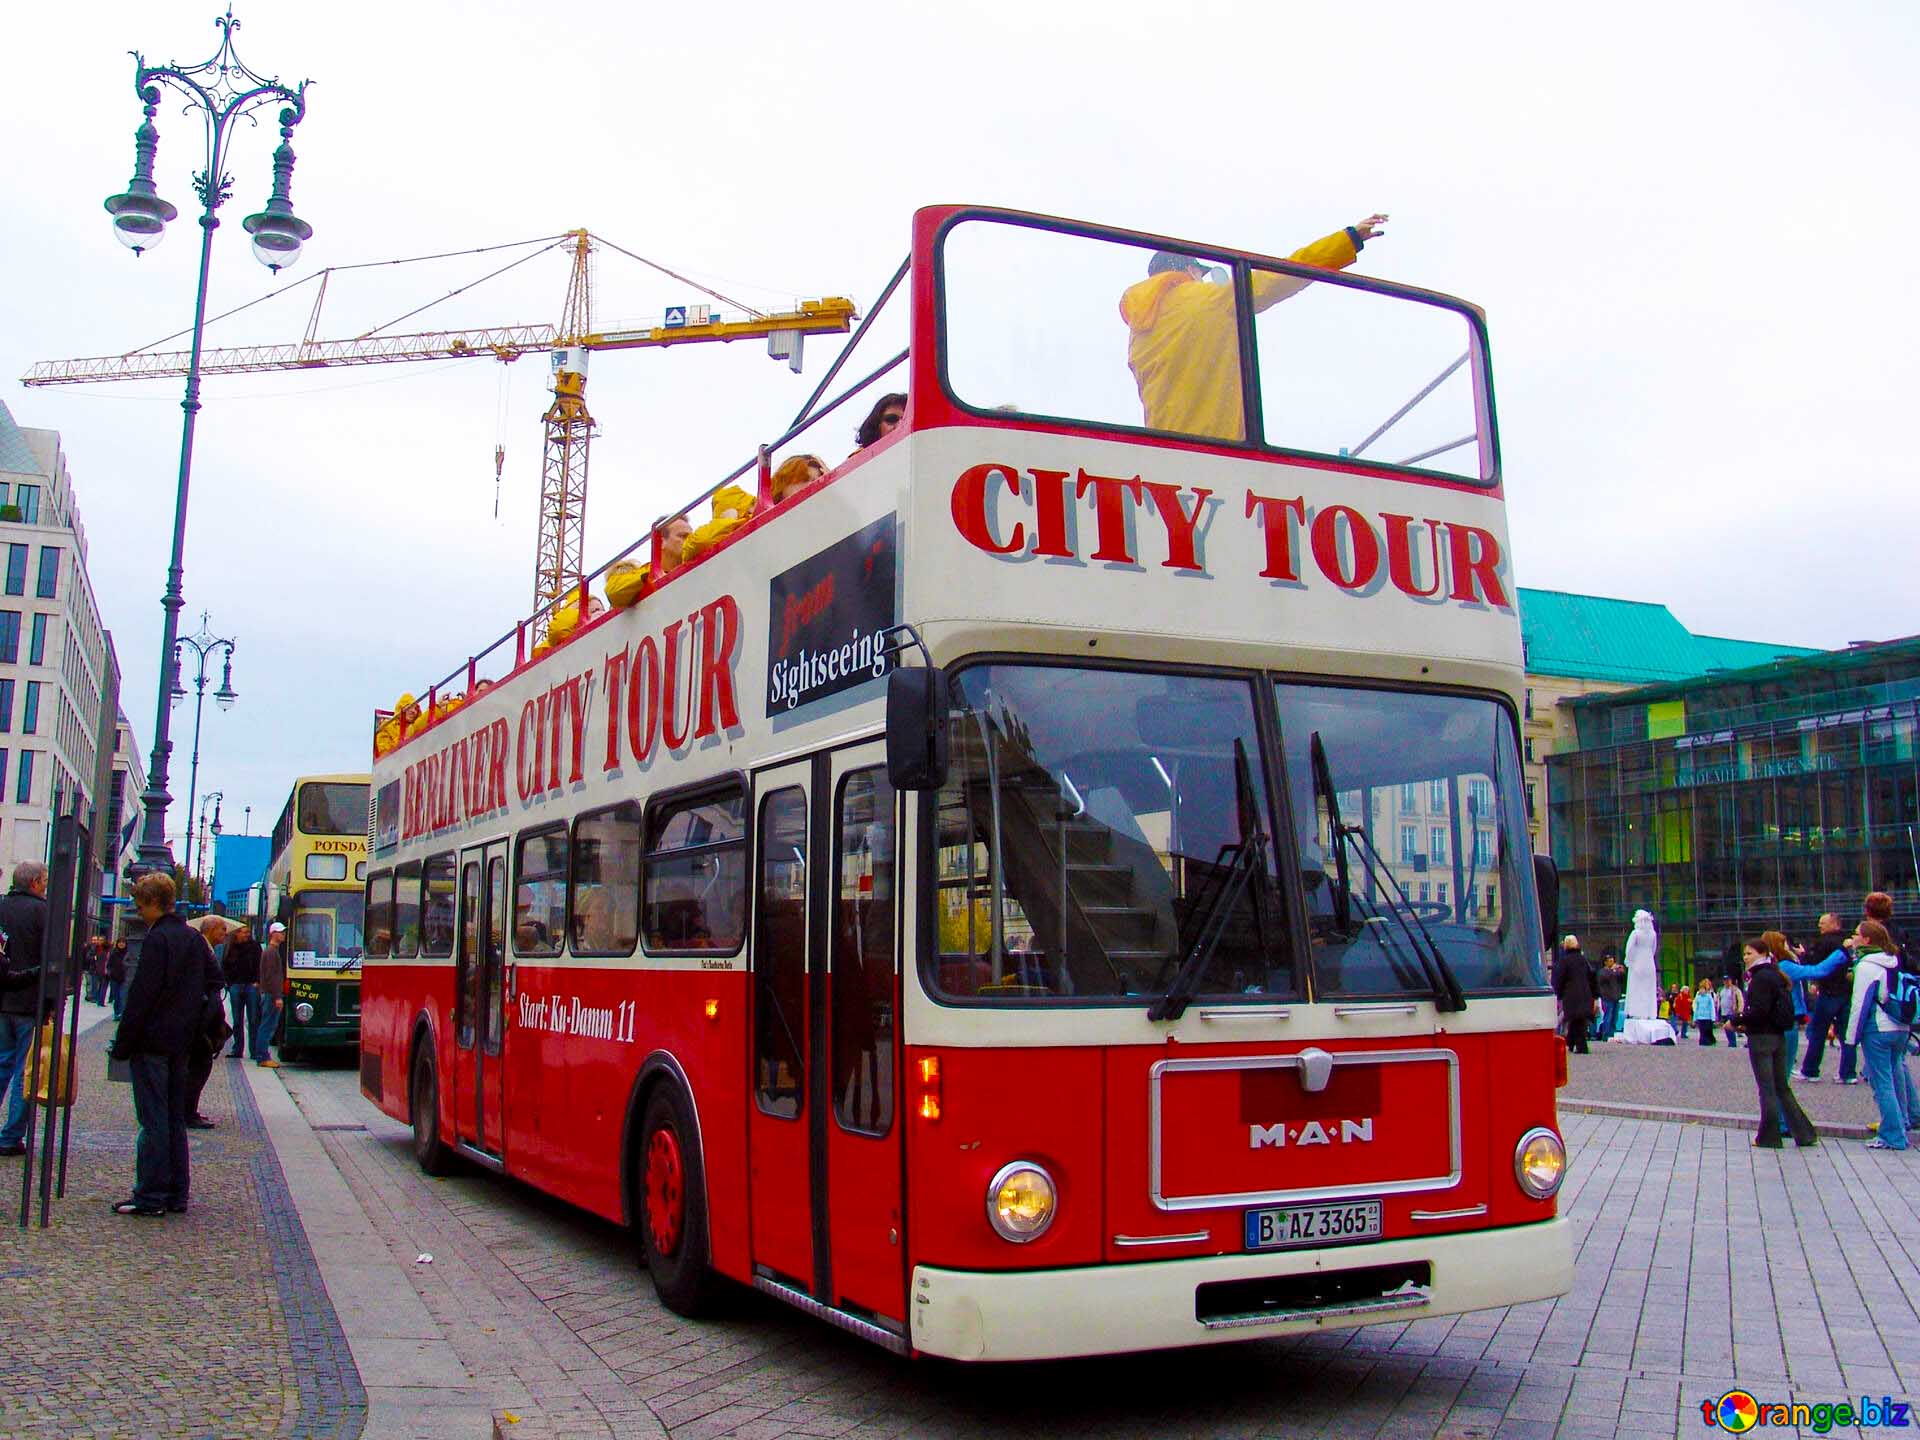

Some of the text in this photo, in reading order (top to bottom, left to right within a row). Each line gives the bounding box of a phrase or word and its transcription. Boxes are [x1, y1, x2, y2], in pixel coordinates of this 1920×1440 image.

[951, 463, 1213, 570] CITY
[1246, 488, 1511, 607] TOUR
[771, 628, 885, 709] Sightseeing
[402, 594, 742, 840] BERLINER CITY TOUR
[314, 840, 367, 852] POTSDA
[518, 992, 548, 1031] Start:
[616, 1000, 636, 1044] 11
[1260, 1215, 1274, 1241] B
[1290, 1211, 1315, 1239] AZ
[1319, 1207, 1366, 1236] 3365
